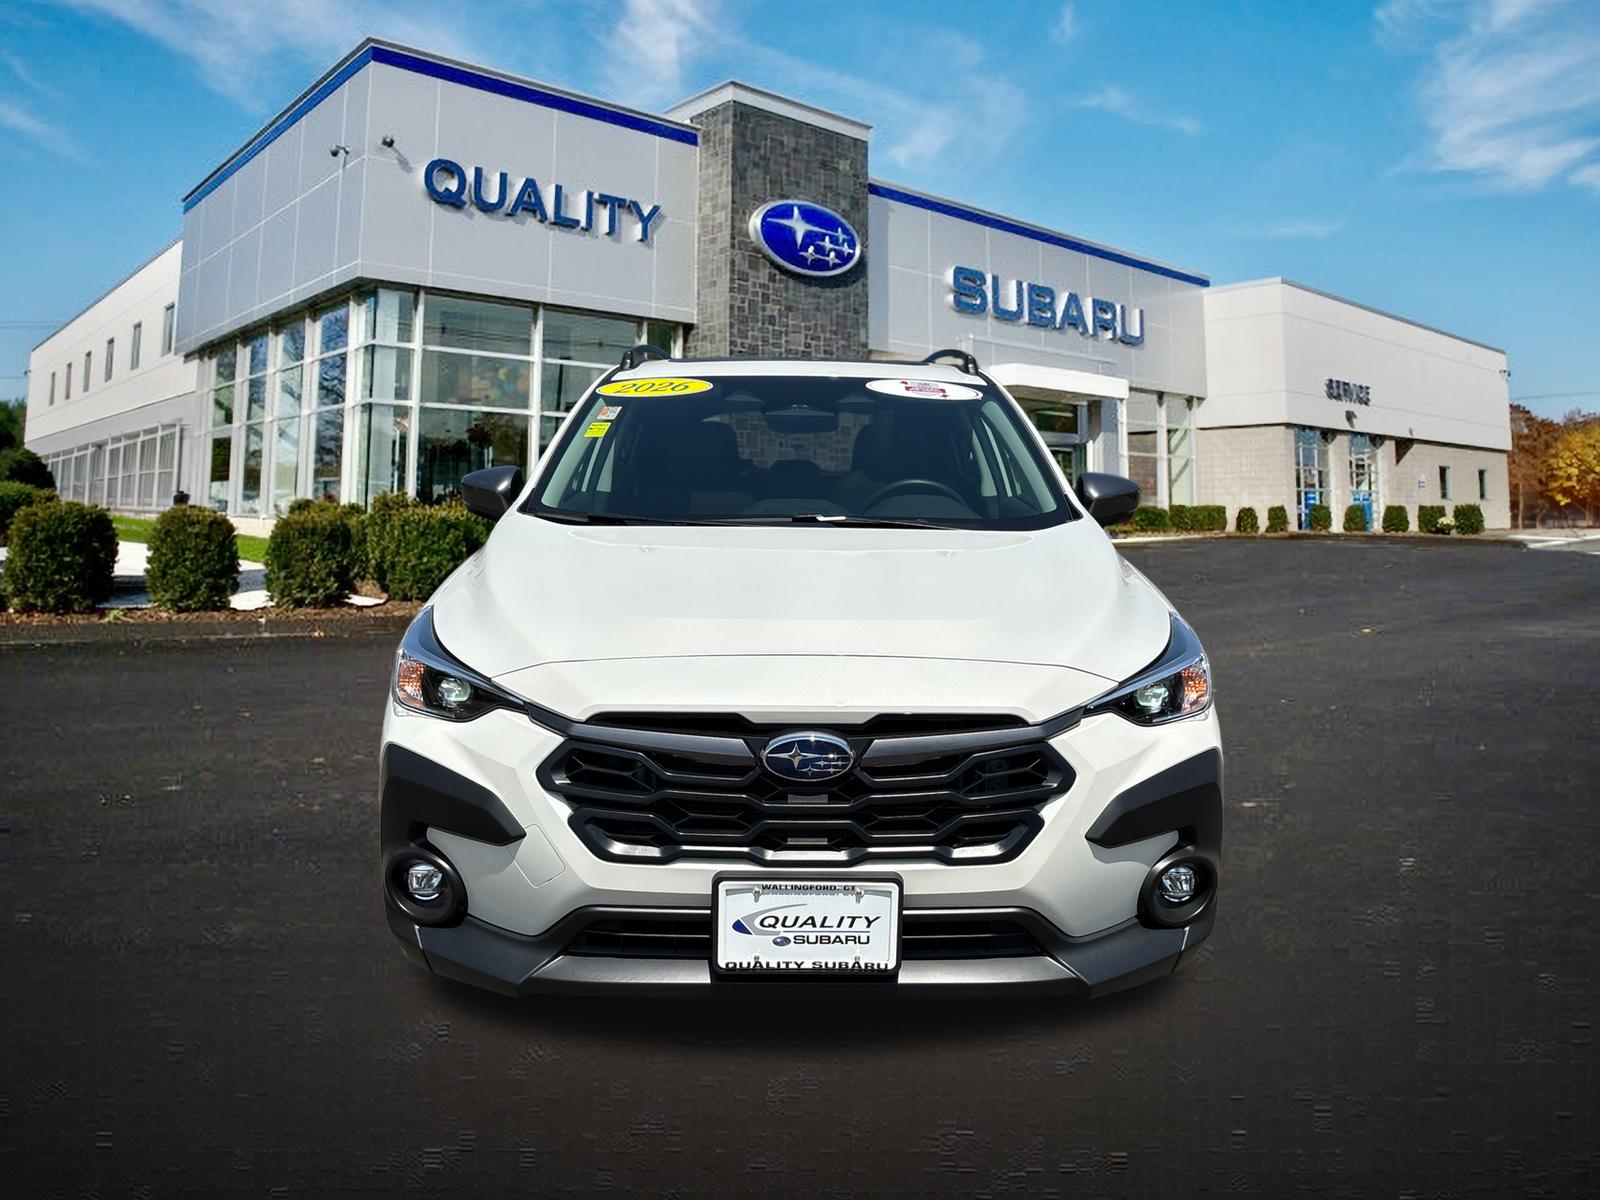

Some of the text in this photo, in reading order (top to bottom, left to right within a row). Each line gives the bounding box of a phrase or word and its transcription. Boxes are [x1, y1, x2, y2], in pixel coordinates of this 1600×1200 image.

[424, 158, 661, 243] QUALITY
[950, 265, 1145, 346] SUBARU
[614, 381, 694, 394] 2026
[1325, 378, 1370, 406] SERVICE
[759, 916, 881, 929] QUALITY
[793, 935, 870, 945] SUBARU
[725, 961, 888, 970] QUALITY SUBARU
